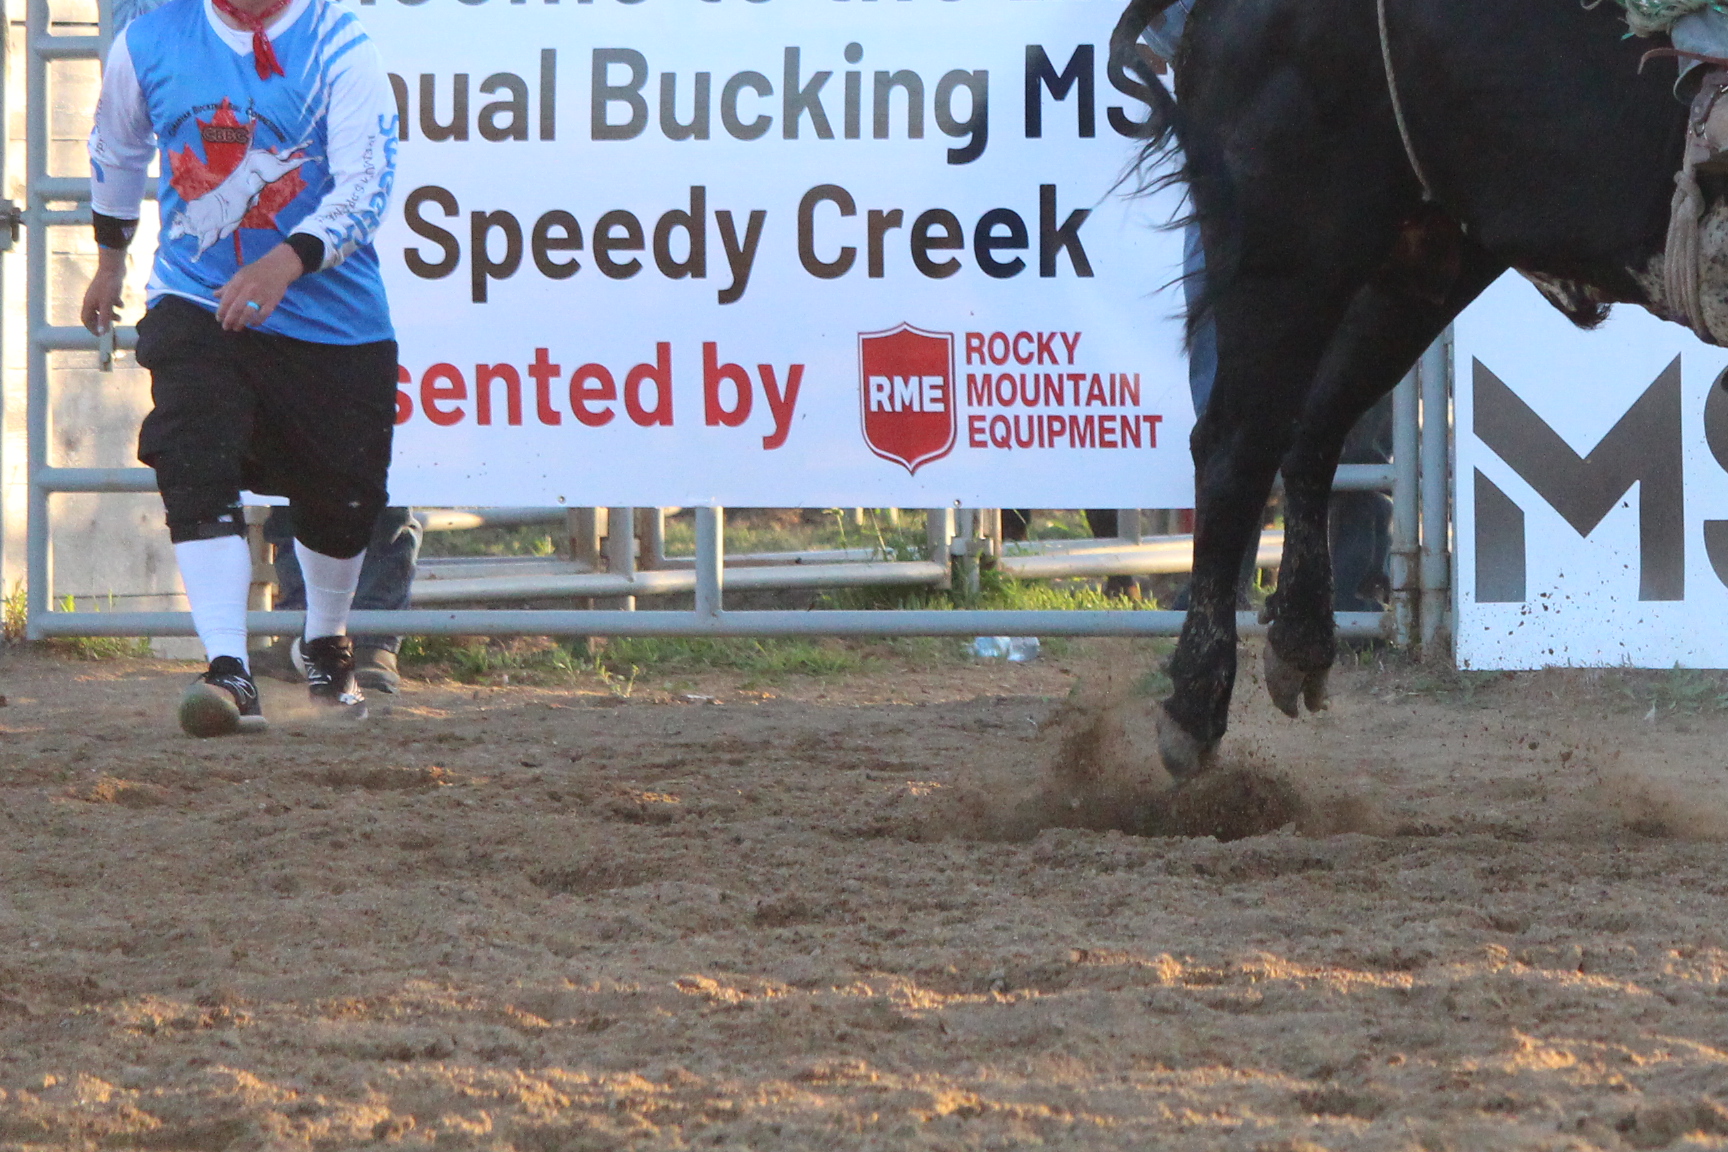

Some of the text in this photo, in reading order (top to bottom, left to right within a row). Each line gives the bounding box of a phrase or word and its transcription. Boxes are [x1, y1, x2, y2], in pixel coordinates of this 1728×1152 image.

[591, 41, 990, 166] Bucking
[403, 183, 1095, 306] Speedy Creek
[965, 330, 1082, 366] ROCKY
[702, 341, 805, 451] by
[868, 373, 947, 415] RME
[966, 372, 1141, 408] MOUNTAIN
[967, 414, 1163, 452] EQUIPMENT
